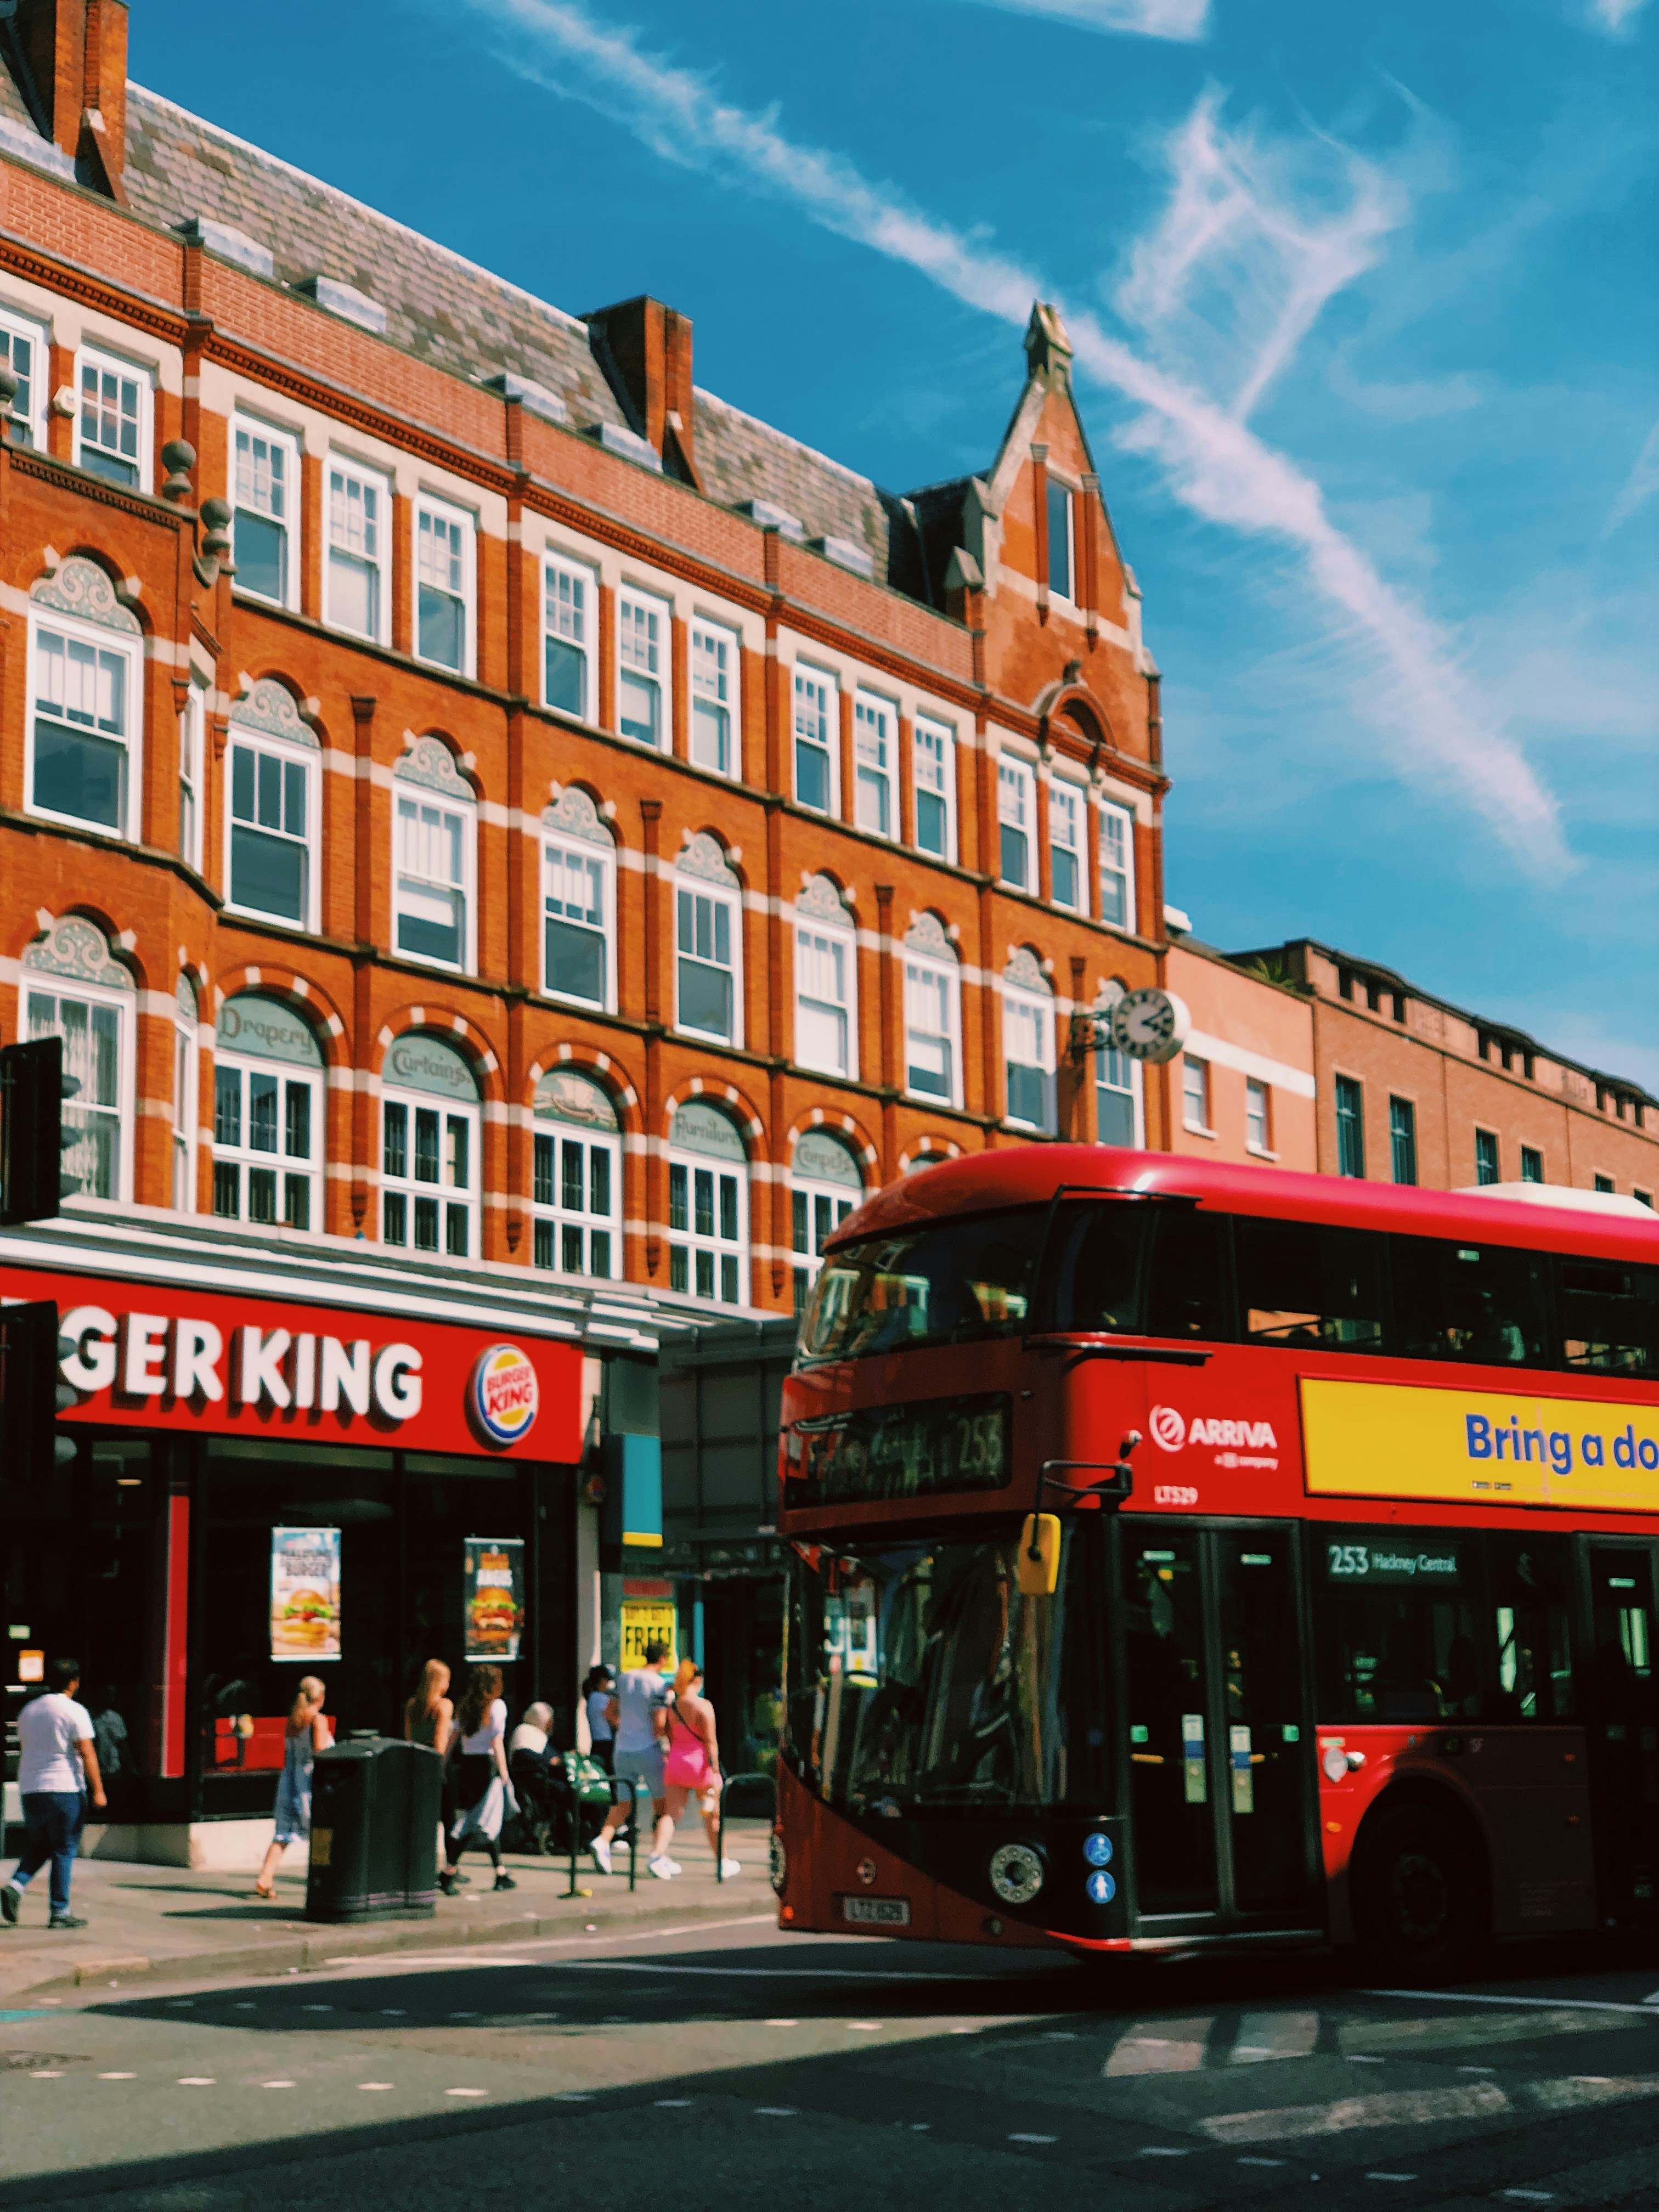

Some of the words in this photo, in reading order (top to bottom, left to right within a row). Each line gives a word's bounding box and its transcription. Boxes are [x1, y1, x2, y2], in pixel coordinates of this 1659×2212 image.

[219, 1006, 313, 1055] Drapery
[241, 1325, 423, 1420] KING
[487, 1366, 530, 1392] BURGER
[487, 1383, 532, 1416] KING
[1188, 1418, 1278, 1449] ARRIVA
[1465, 1414, 1573, 1475] Bring
[1582, 1434, 1604, 1466] a
[1328, 1544, 1369, 1574] 253
[1372, 1551, 1416, 1575] Hackney
